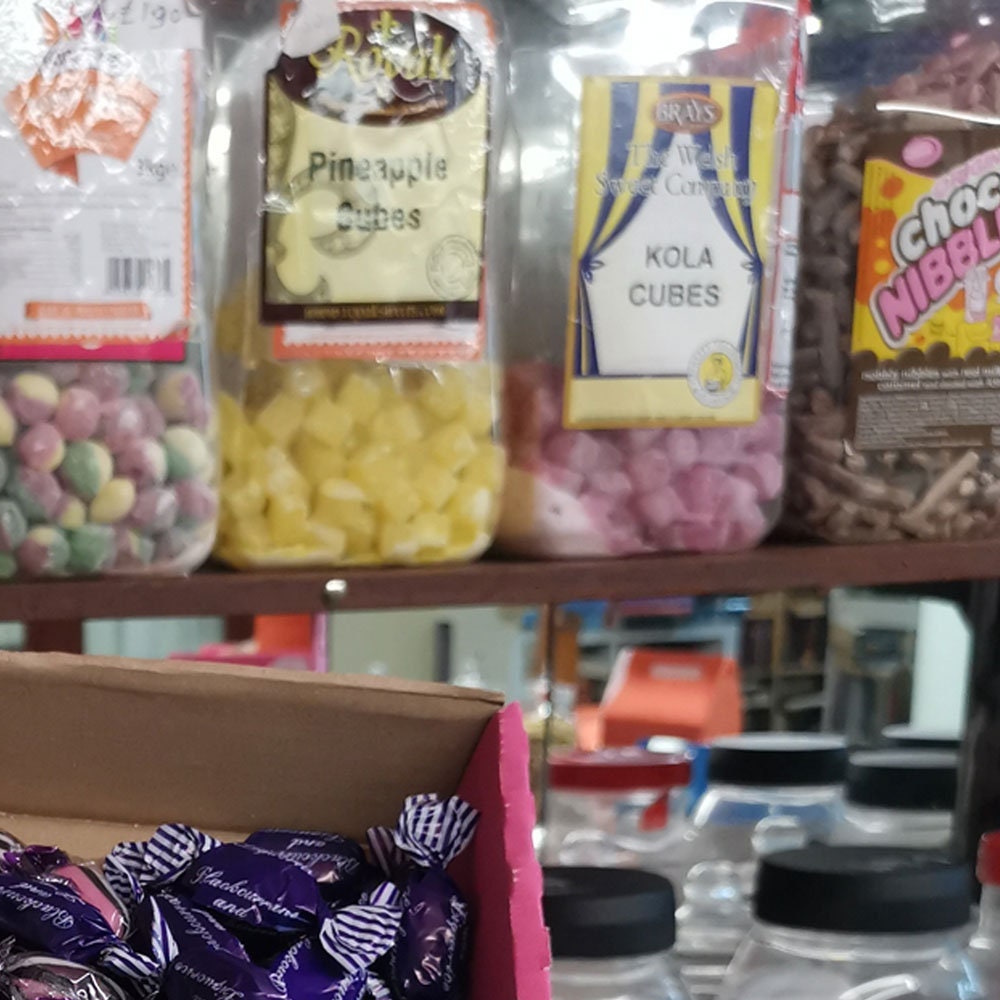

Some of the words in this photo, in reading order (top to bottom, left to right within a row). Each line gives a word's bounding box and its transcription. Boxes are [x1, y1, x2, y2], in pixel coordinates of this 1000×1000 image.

[656, 98, 717, 127] BRAYS
[308, 151, 448, 188] Pineapple
[336, 201, 422, 232] Cubes
[645, 245, 714, 269] KOLA
[877, 206, 1000, 341] NIBBL
[628, 283, 721, 308] CUBES
